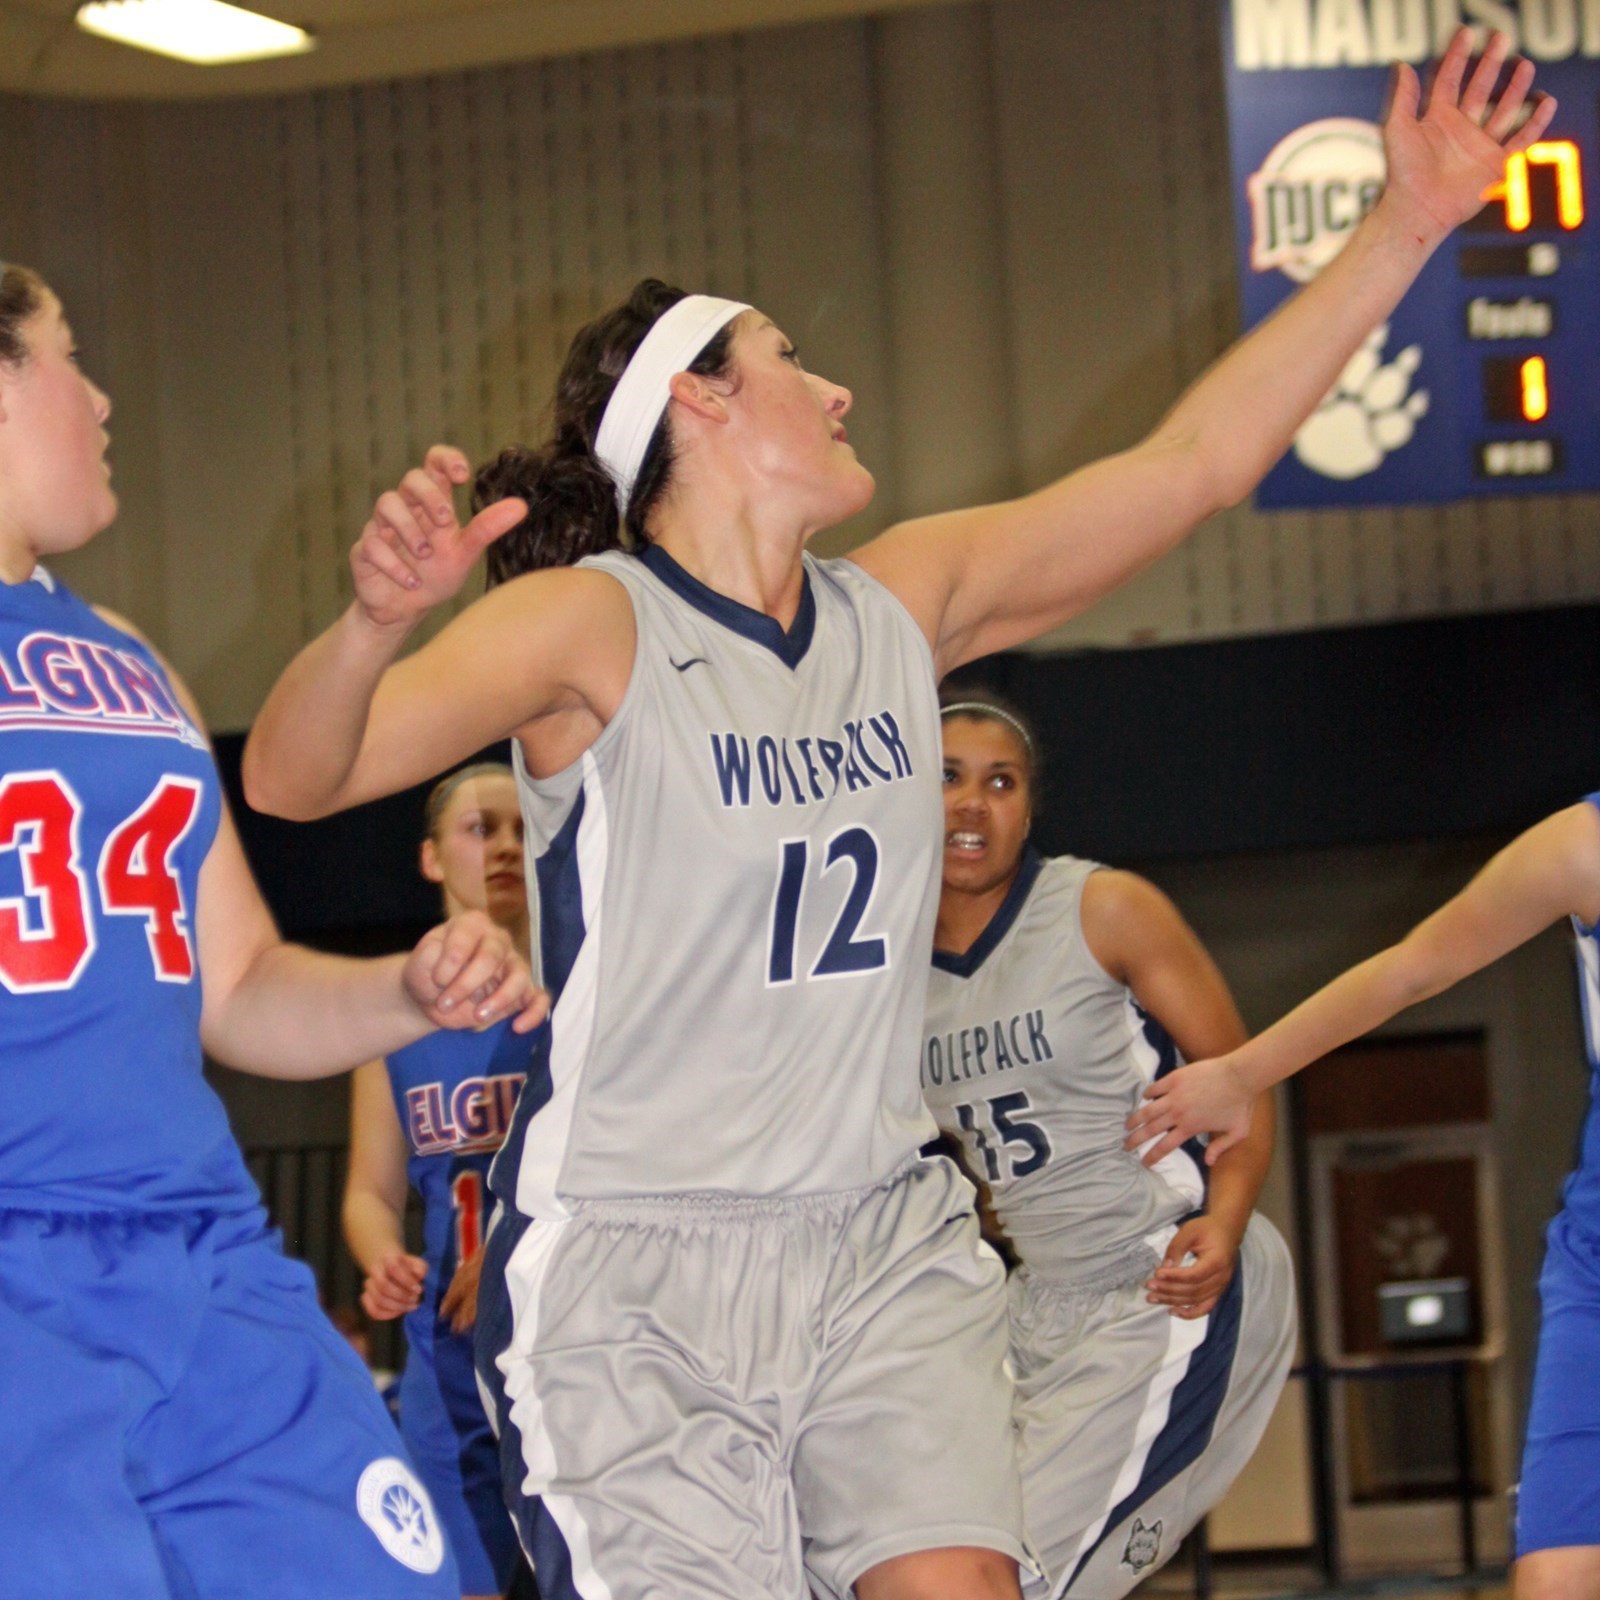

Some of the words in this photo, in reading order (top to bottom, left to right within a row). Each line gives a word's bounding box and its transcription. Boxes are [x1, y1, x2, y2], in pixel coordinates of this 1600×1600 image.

[1234, 0, 1600, 70] MADISO
[1520, 355, 1548, 422] 1
[708, 709, 914, 808] WOLFPACK
[0, 769, 203, 994] 34
[765, 822, 890, 989] 12
[920, 1008, 1054, 1089] OLFPACK
[954, 1088, 1054, 1185] 15
